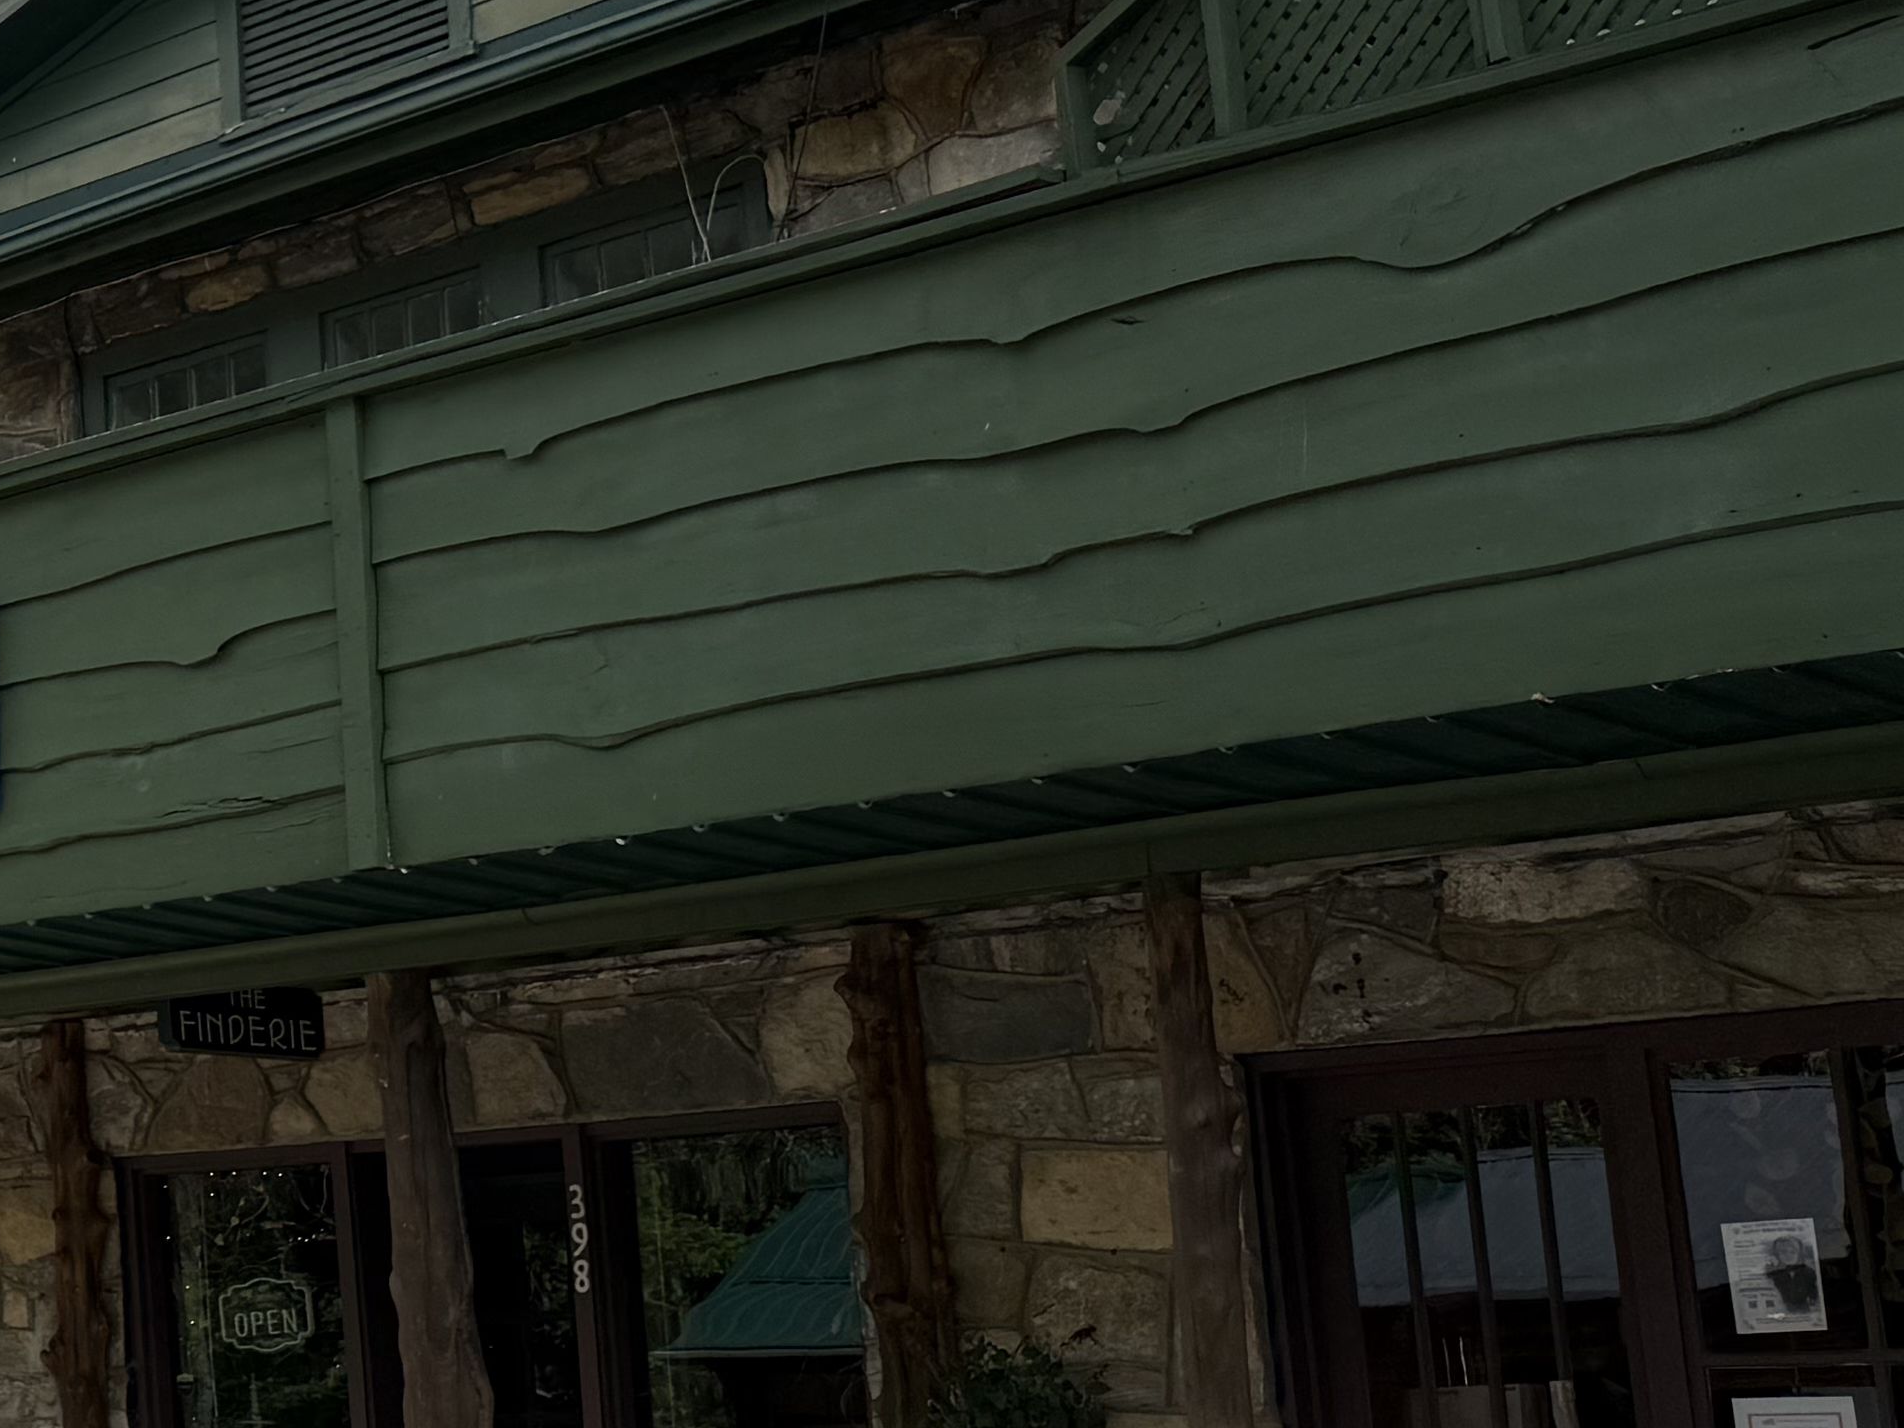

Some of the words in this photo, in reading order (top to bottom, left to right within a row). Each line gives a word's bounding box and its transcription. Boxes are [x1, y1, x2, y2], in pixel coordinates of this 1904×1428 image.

[179, 1010, 318, 1051] FINDERIE
[569, 1183, 591, 1294] 398
[233, 1307, 298, 1338] OPEN
